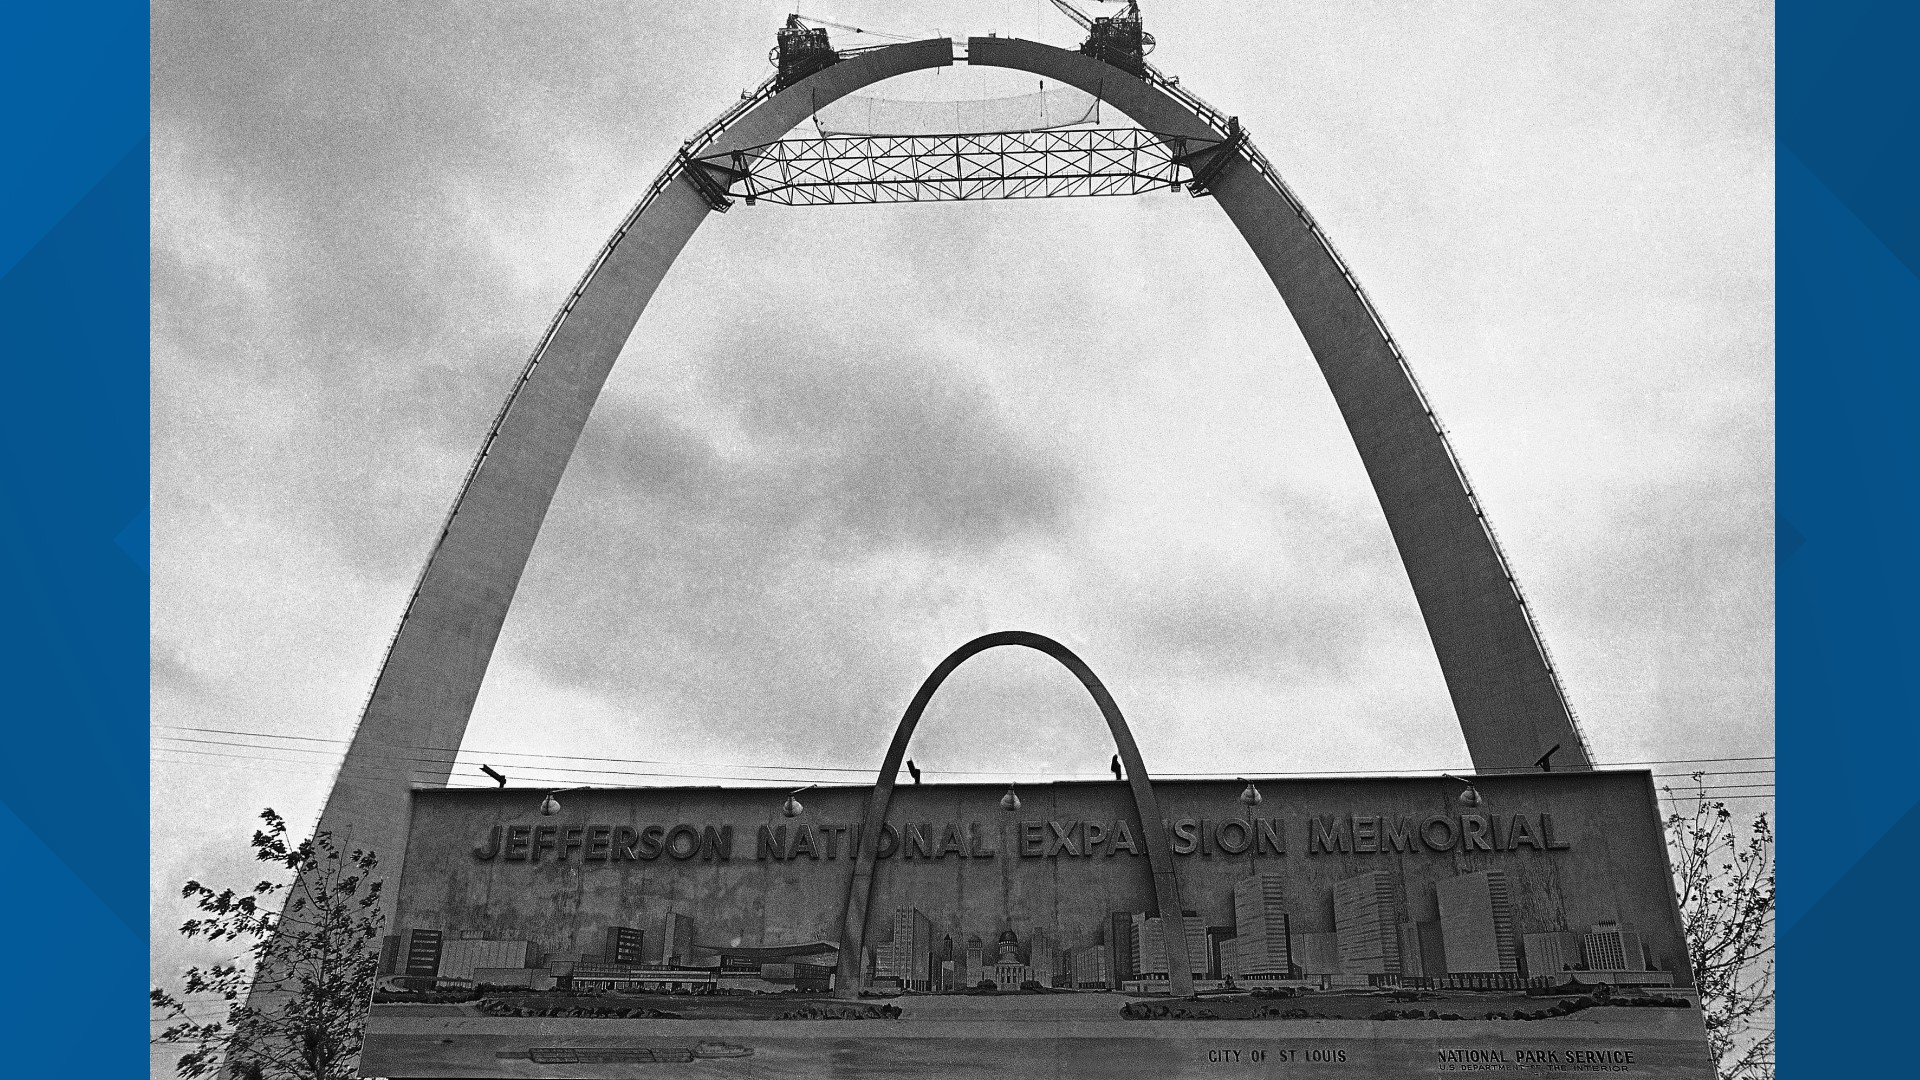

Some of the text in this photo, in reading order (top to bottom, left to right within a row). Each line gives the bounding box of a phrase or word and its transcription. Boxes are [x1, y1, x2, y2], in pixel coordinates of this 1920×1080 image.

[473, 823, 733, 862] JEFFERSON
[1018, 817, 1287, 858] EXPASION
[1310, 812, 1572, 854] MEMORIAL
[1208, 1049, 1347, 1063] CITY OF ST LOUIS
[1438, 1049, 1635, 1064] NATIONAL PARK SERVICE
[1547, 1064, 1567, 1072] THE
